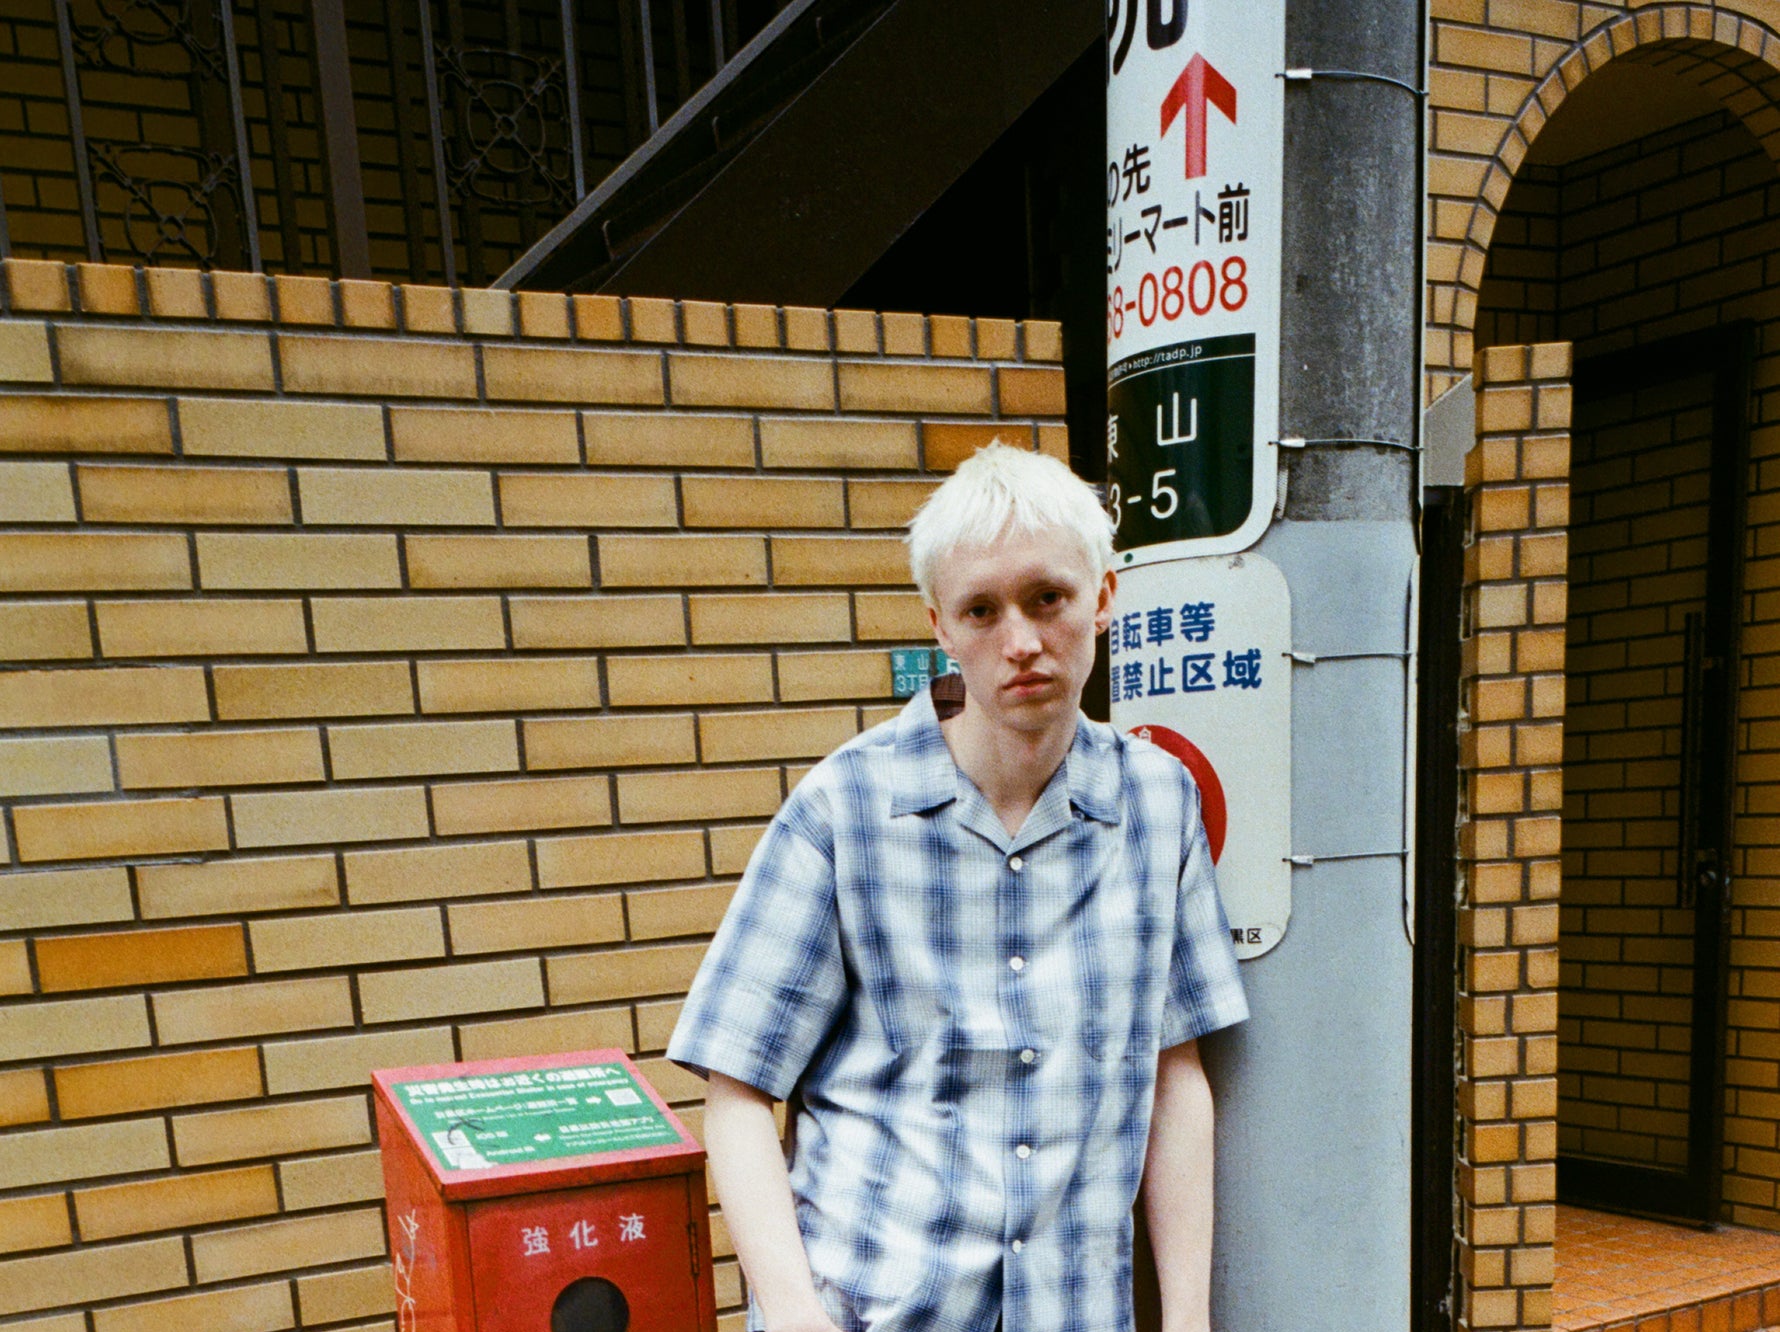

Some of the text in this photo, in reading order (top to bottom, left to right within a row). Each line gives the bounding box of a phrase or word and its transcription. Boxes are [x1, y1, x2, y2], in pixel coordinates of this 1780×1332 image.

[1110, 468, 1178, 531] 3-5
[521, 1212, 646, 1256] 強化液
